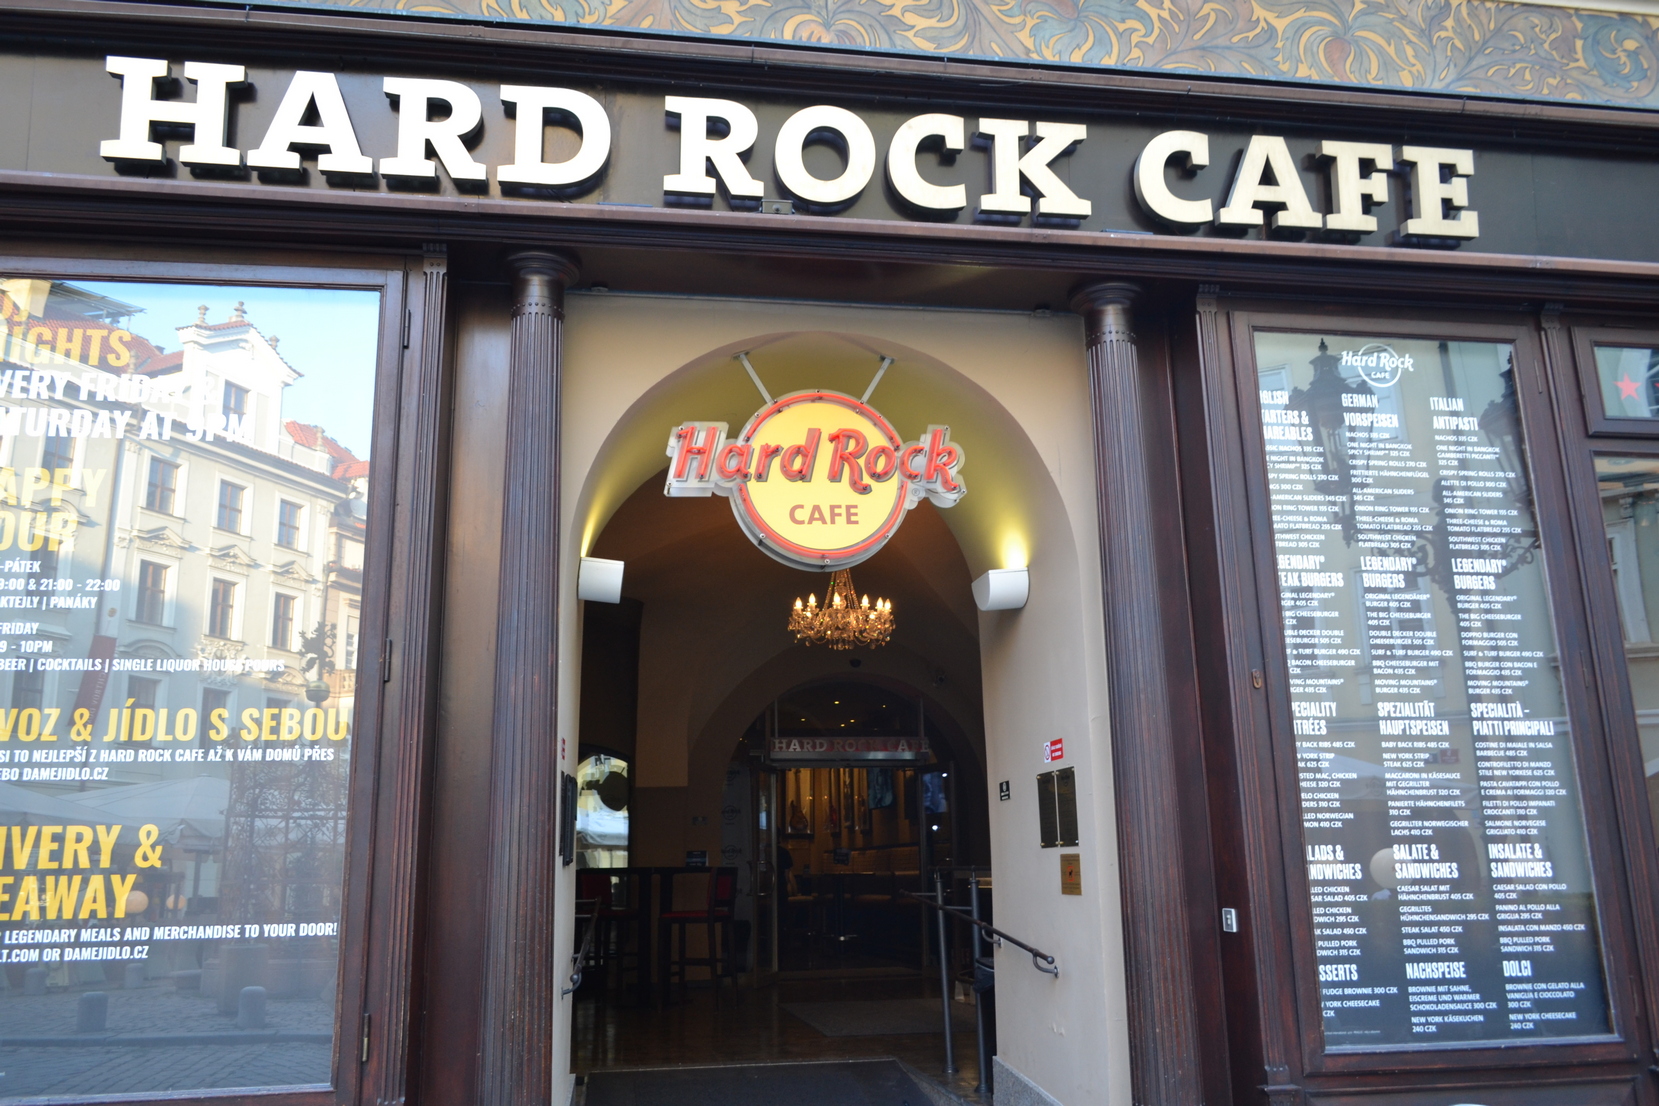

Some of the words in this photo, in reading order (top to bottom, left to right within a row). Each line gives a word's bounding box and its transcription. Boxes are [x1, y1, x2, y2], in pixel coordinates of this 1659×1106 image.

[99, 55, 611, 189] HARD
[664, 95, 1091, 219] ROCK
[1133, 130, 1479, 238] CAFE
[1341, 351, 1377, 367] Hard
[1379, 353, 1414, 371] Rock
[1342, 394, 1378, 408] GERMAN
[1430, 397, 1464, 411] ITALIAN
[140, 411, 176, 440] AT
[1343, 412, 1398, 427] VORSPEISEN
[1433, 416, 1478, 431] ANTIPASTI
[672, 426, 822, 483] Hard
[828, 427, 960, 495] Rock
[789, 504, 860, 525] CAFE
[28, 578, 36, 590] &
[40, 578, 74, 591] 21:00
[85, 579, 120, 592] 22:00
[1301, 572, 1344, 587] BURGERS
[1363, 573, 1405, 588] BURGERS
[1454, 575, 1496, 590] BURGERS
[50, 593, 98, 608] PANÁKY
[20, 640, 53, 653] 10PM
[37, 658, 102, 671] COCKTAILS
[112, 659, 154, 671] SINGLE
[156, 659, 200, 673] LIQUOR
[204, 659, 242, 672] HOUSE
[245, 659, 285, 672] POURS
[1377, 700, 1435, 717] SPEZIALITÄT
[1470, 701, 1523, 718] SPECIALITÀ
[70, 708, 93, 742] &
[103, 698, 198, 742] JÍDLO
[208, 708, 229, 741] S
[240, 708, 348, 741] SEBOU
[1379, 720, 1449, 735] HAUPTSPEISEN
[1473, 721, 1503, 735] PIATTI
[1504, 721, 1554, 736] PRINCIPALI
[14, 750, 29, 762] TO
[32, 746, 88, 762] NEJLEPŠÍ
[90, 750, 97, 762] Z
[100, 749, 134, 762] HARD
[138, 749, 172, 762] ROCK
[175, 749, 205, 762] CAFE
[207, 746, 223, 761] AŽ
[225, 749, 234, 761] K
[238, 745, 262, 761] VÁM
[265, 745, 300, 761] DOMŮ
[304, 745, 335, 761] PŘES
[774, 739, 828, 752] HARD
[23, 768, 109, 780] DAMEJIDLO.CZ
[134, 824, 162, 868] &
[1306, 845, 1334, 860] LADS
[1336, 844, 1344, 860] &
[1393, 844, 1429, 860] SALATE
[1430, 844, 1439, 860] &
[1488, 843, 1533, 859] INSALATE
[1534, 843, 1542, 858] &
[1308, 863, 1362, 880] NDWICHES
[1395, 863, 1458, 879] SANDWICHES
[1491, 862, 1553, 878] SANDWICHES
[4, 928, 77, 944] LEGENDARY
[80, 928, 121, 942] MEALS
[124, 927, 150, 941] AND
[153, 924, 241, 940] MERCHANDISE
[244, 924, 259, 938] TO
[263, 924, 296, 937] YOUR
[299, 922, 337, 936] DOOR!
[0, 948, 39, 962] T.COM
[42, 948, 61, 962] OR
[64, 946, 149, 961] DAMEJIDLO.CZ
[1319, 964, 1358, 981] SSERTS
[1406, 962, 1466, 979] NACHSPEISE
[1502, 960, 1532, 977] DOLCI
